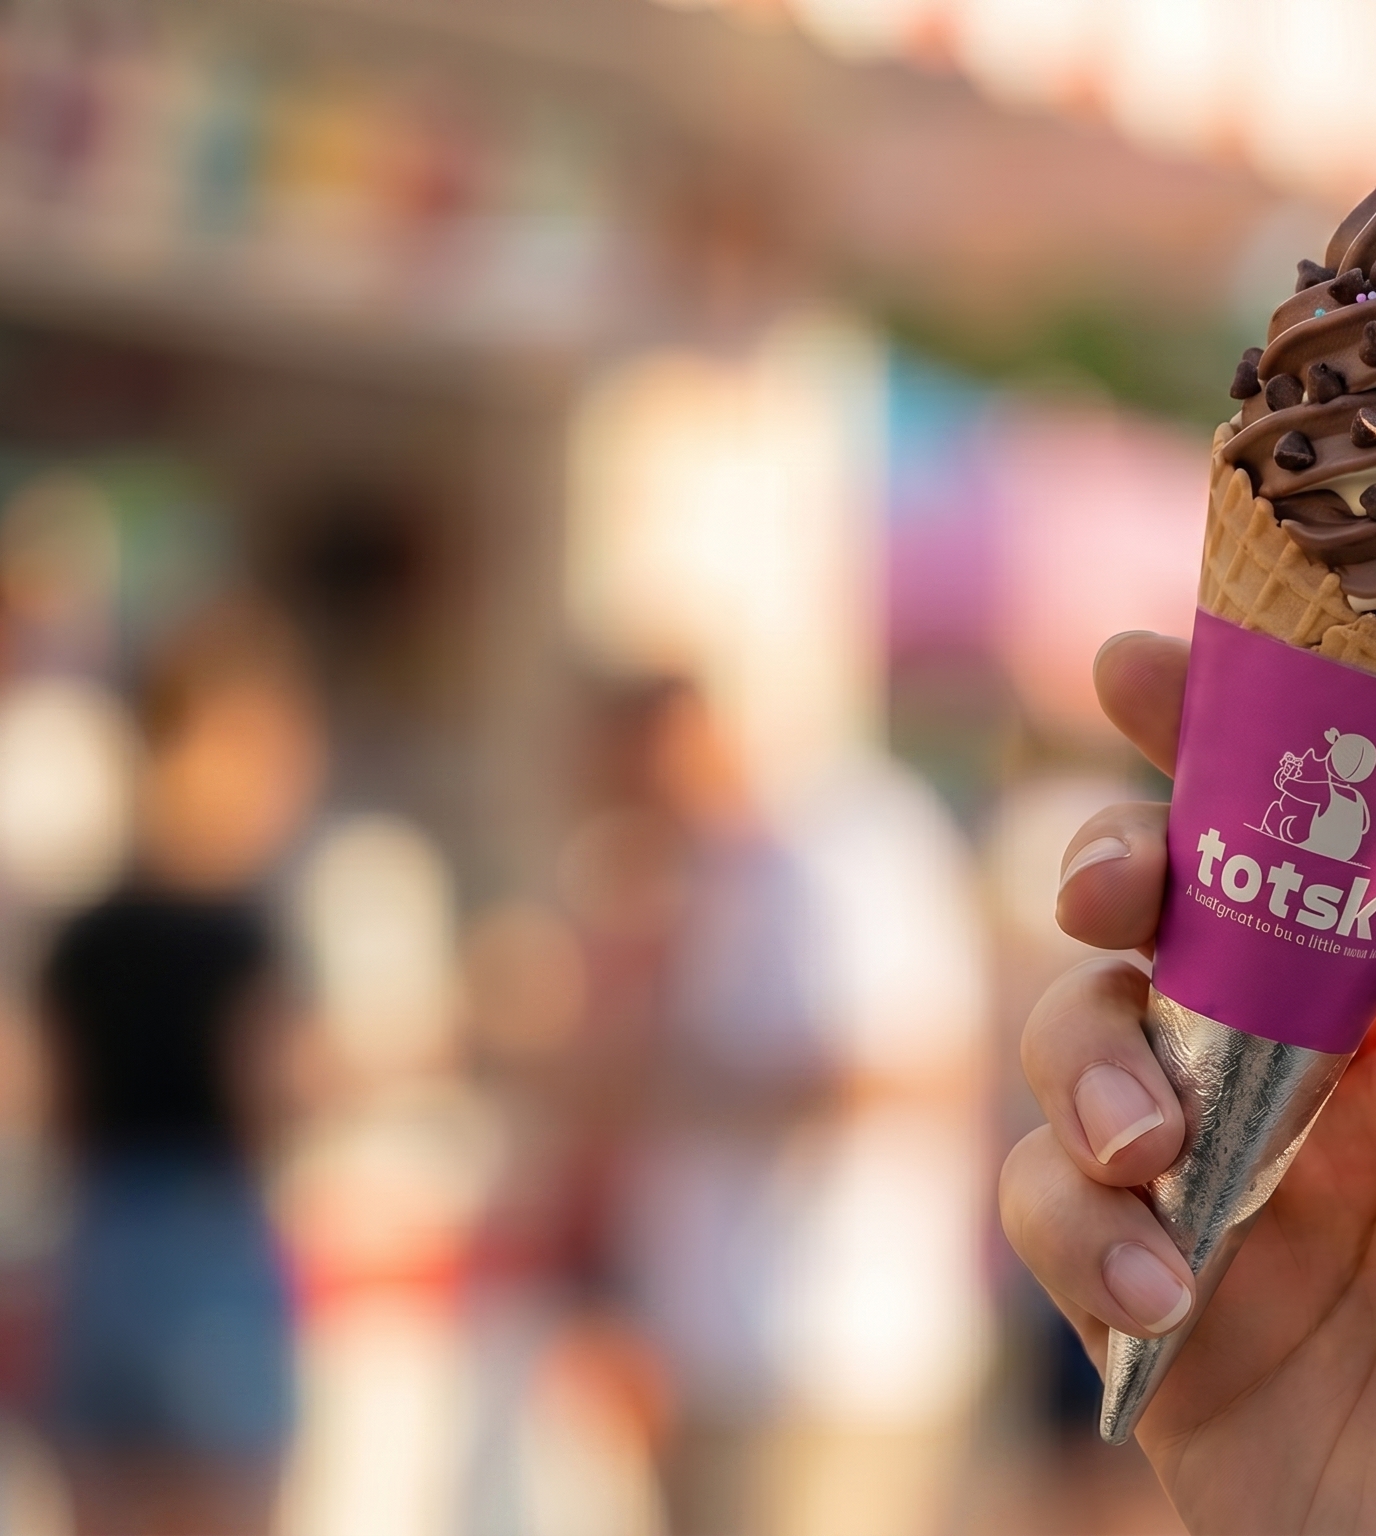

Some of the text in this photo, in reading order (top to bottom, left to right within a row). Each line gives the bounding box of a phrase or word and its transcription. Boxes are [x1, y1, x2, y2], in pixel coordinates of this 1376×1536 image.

[1186, 884, 1193, 896] A
[1255, 918, 1271, 933] to
[1295, 934, 1306, 946] a
[1308, 934, 1341, 954] little
